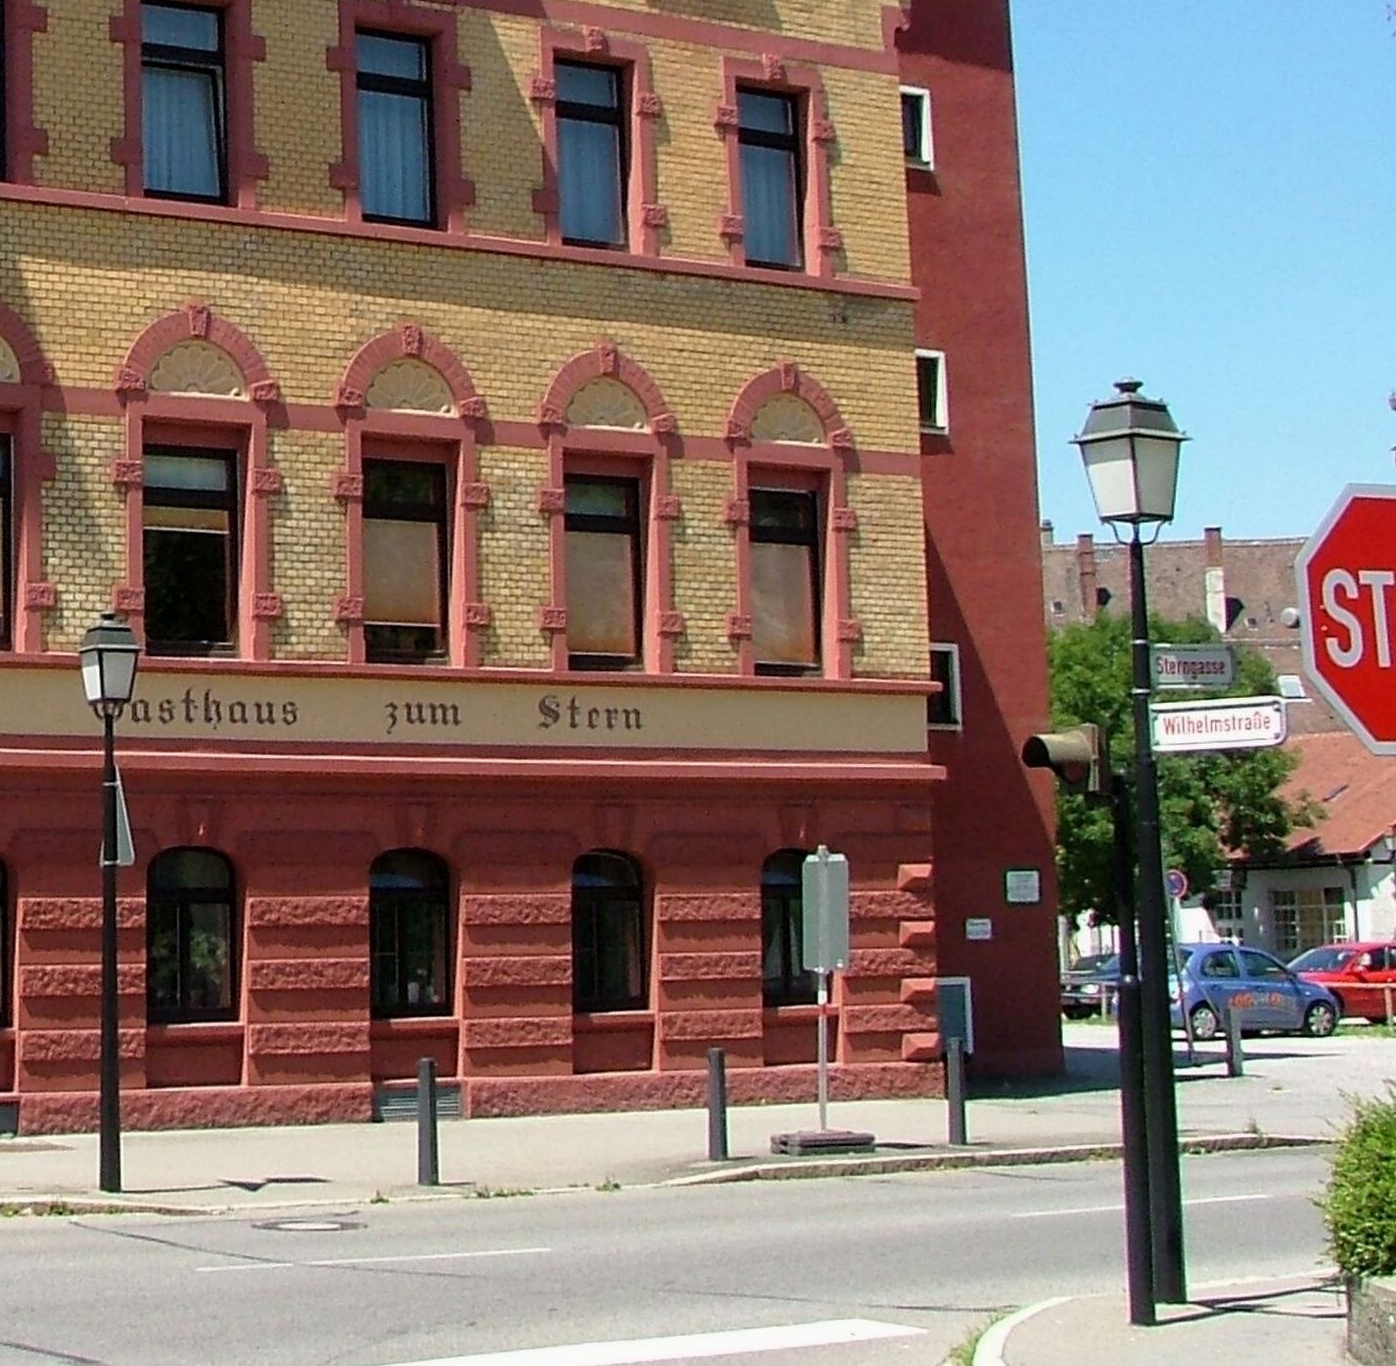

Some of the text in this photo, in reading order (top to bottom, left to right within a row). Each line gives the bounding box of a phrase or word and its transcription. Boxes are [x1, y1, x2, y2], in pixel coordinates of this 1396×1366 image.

[1156, 656, 1226, 680] Sterngasse
[130, 687, 643, 735] asthaus zum Stern
[1163, 711, 1271, 735] Wilhelmstraße
